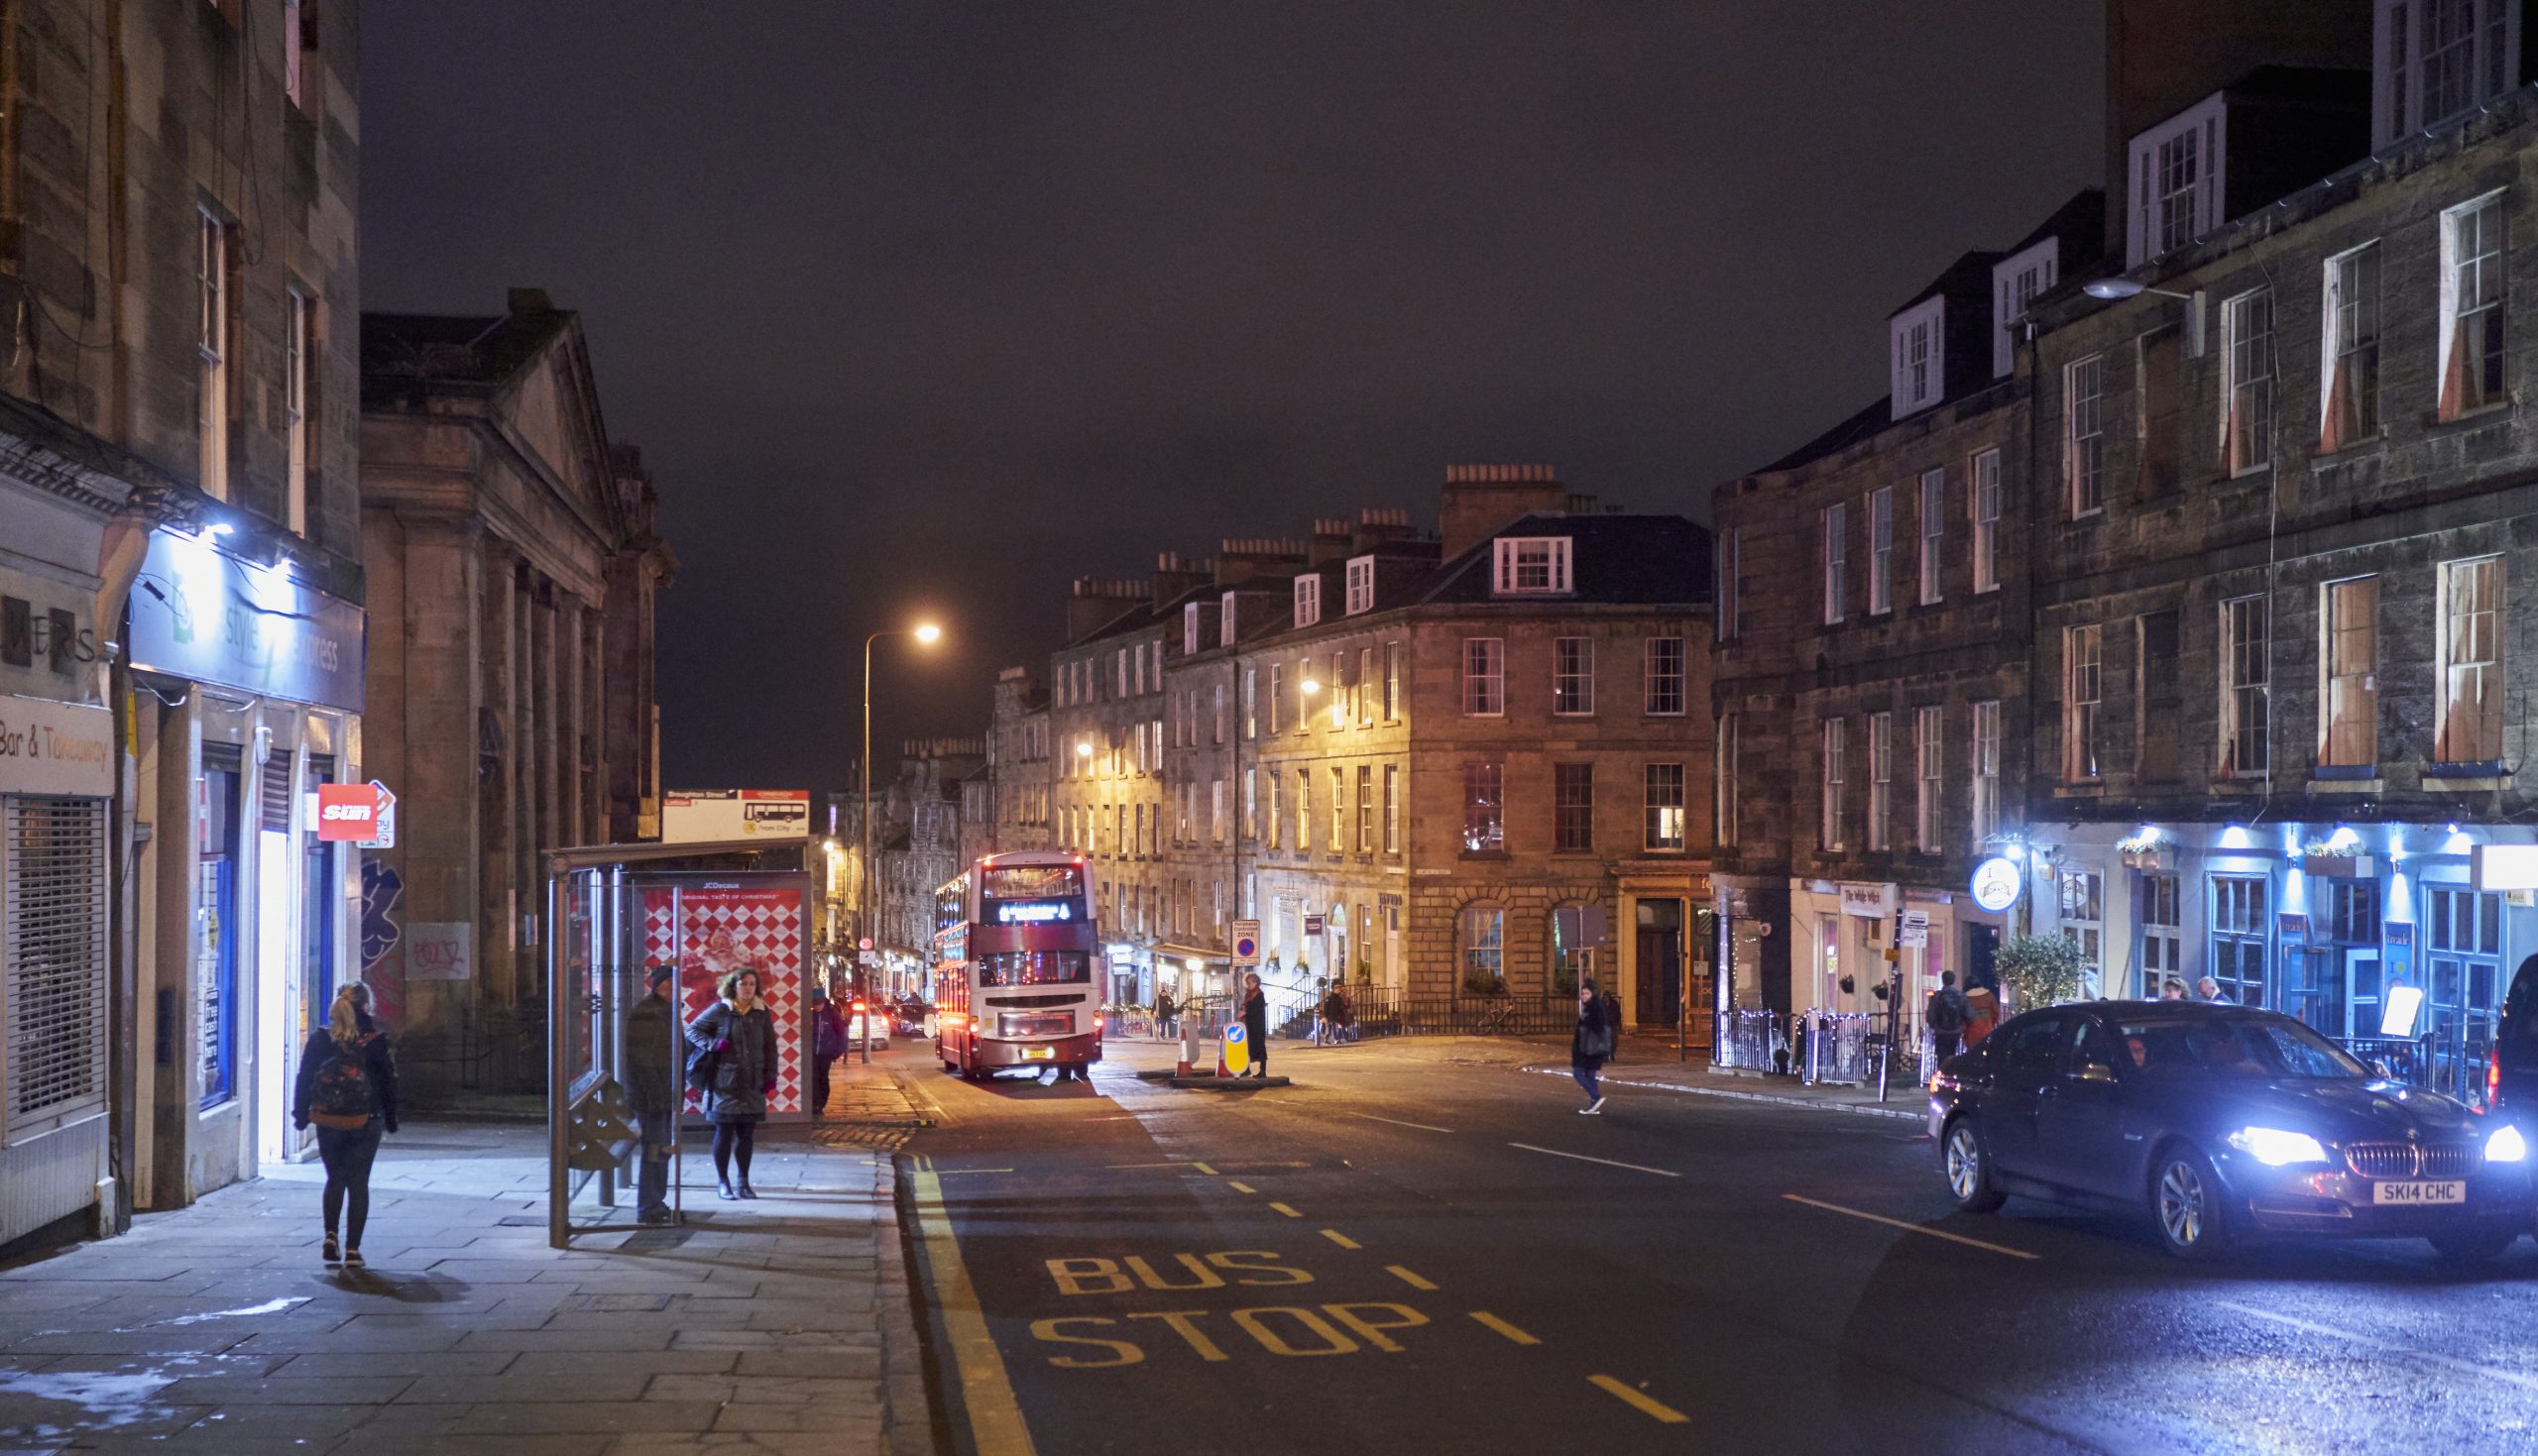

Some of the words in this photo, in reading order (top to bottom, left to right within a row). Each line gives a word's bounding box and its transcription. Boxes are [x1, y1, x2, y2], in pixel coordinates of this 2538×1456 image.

[28, 724, 39, 758] &
[2384, 1183, 2420, 1200] SK14
[2425, 1183, 2455, 1199] CHC
[1045, 1251, 1314, 1294] BUS
[1029, 1302, 1430, 1368] STOP
